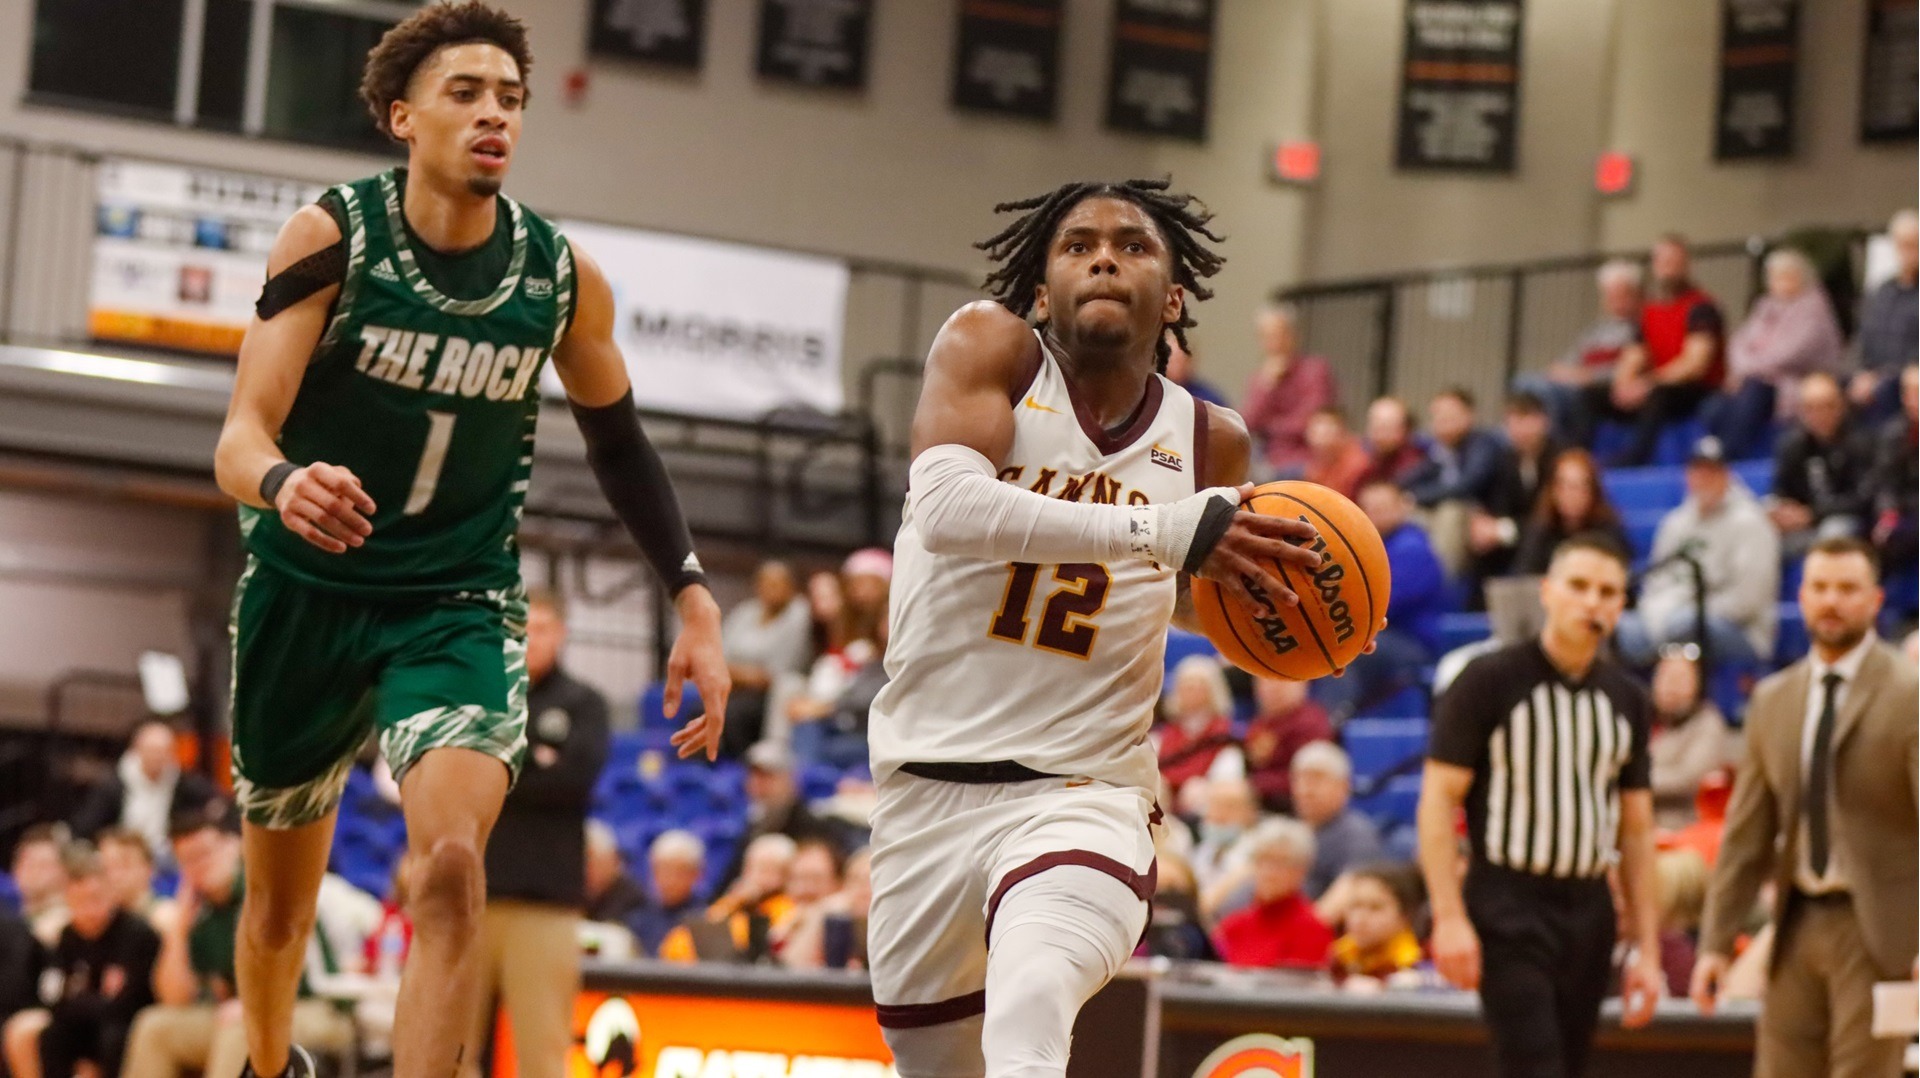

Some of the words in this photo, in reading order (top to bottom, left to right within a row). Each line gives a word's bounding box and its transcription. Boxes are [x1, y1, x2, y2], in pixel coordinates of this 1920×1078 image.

[355, 325, 440, 391] THE
[427, 336, 545, 401] ROCK
[403, 410, 457, 514] 1
[1151, 448, 1183, 469] PSAC
[987, 561, 1114, 661] 12
